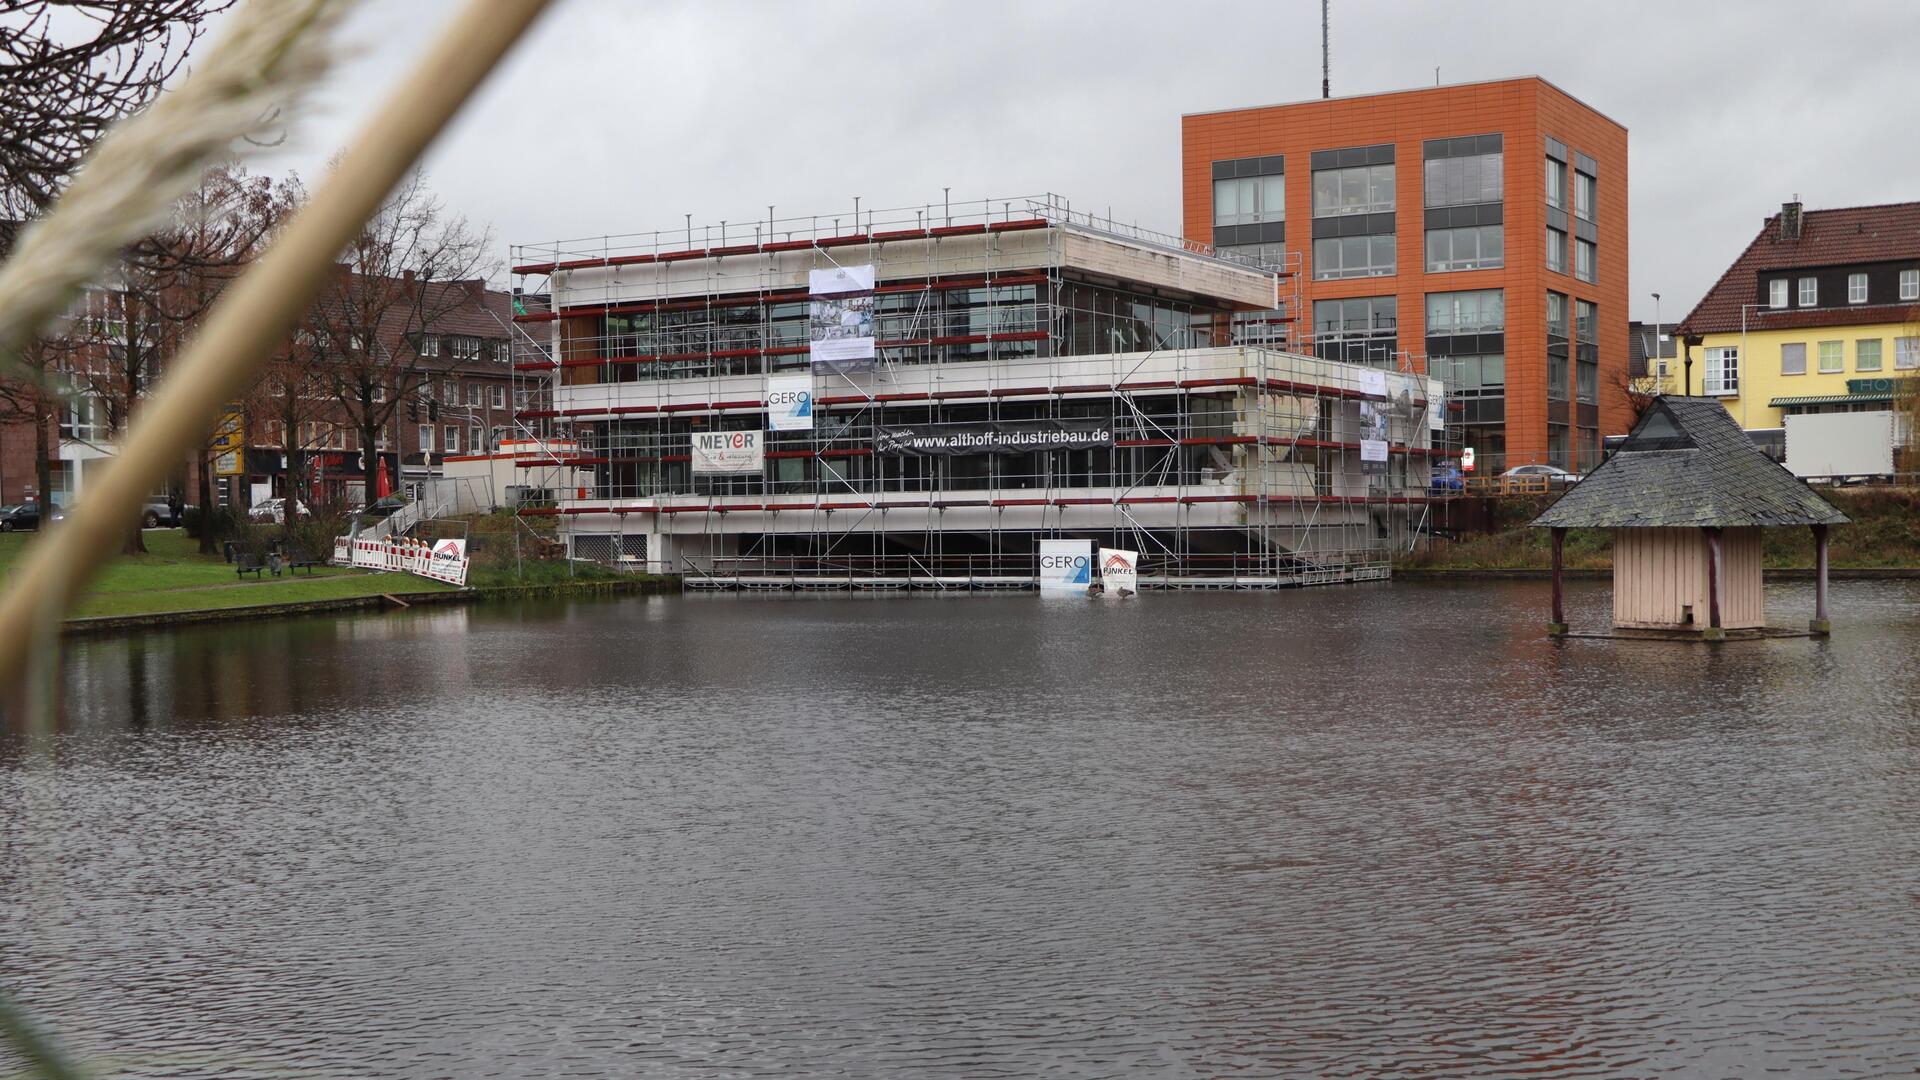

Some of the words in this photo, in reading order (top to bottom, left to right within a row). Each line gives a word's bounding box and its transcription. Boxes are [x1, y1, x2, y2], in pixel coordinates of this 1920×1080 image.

[769, 391, 808, 404] GERO
[913, 428, 1109, 448] www.althoff-industriebau.de
[434, 551, 461, 562] RUNKEL
[1041, 556, 1087, 569] GERO
